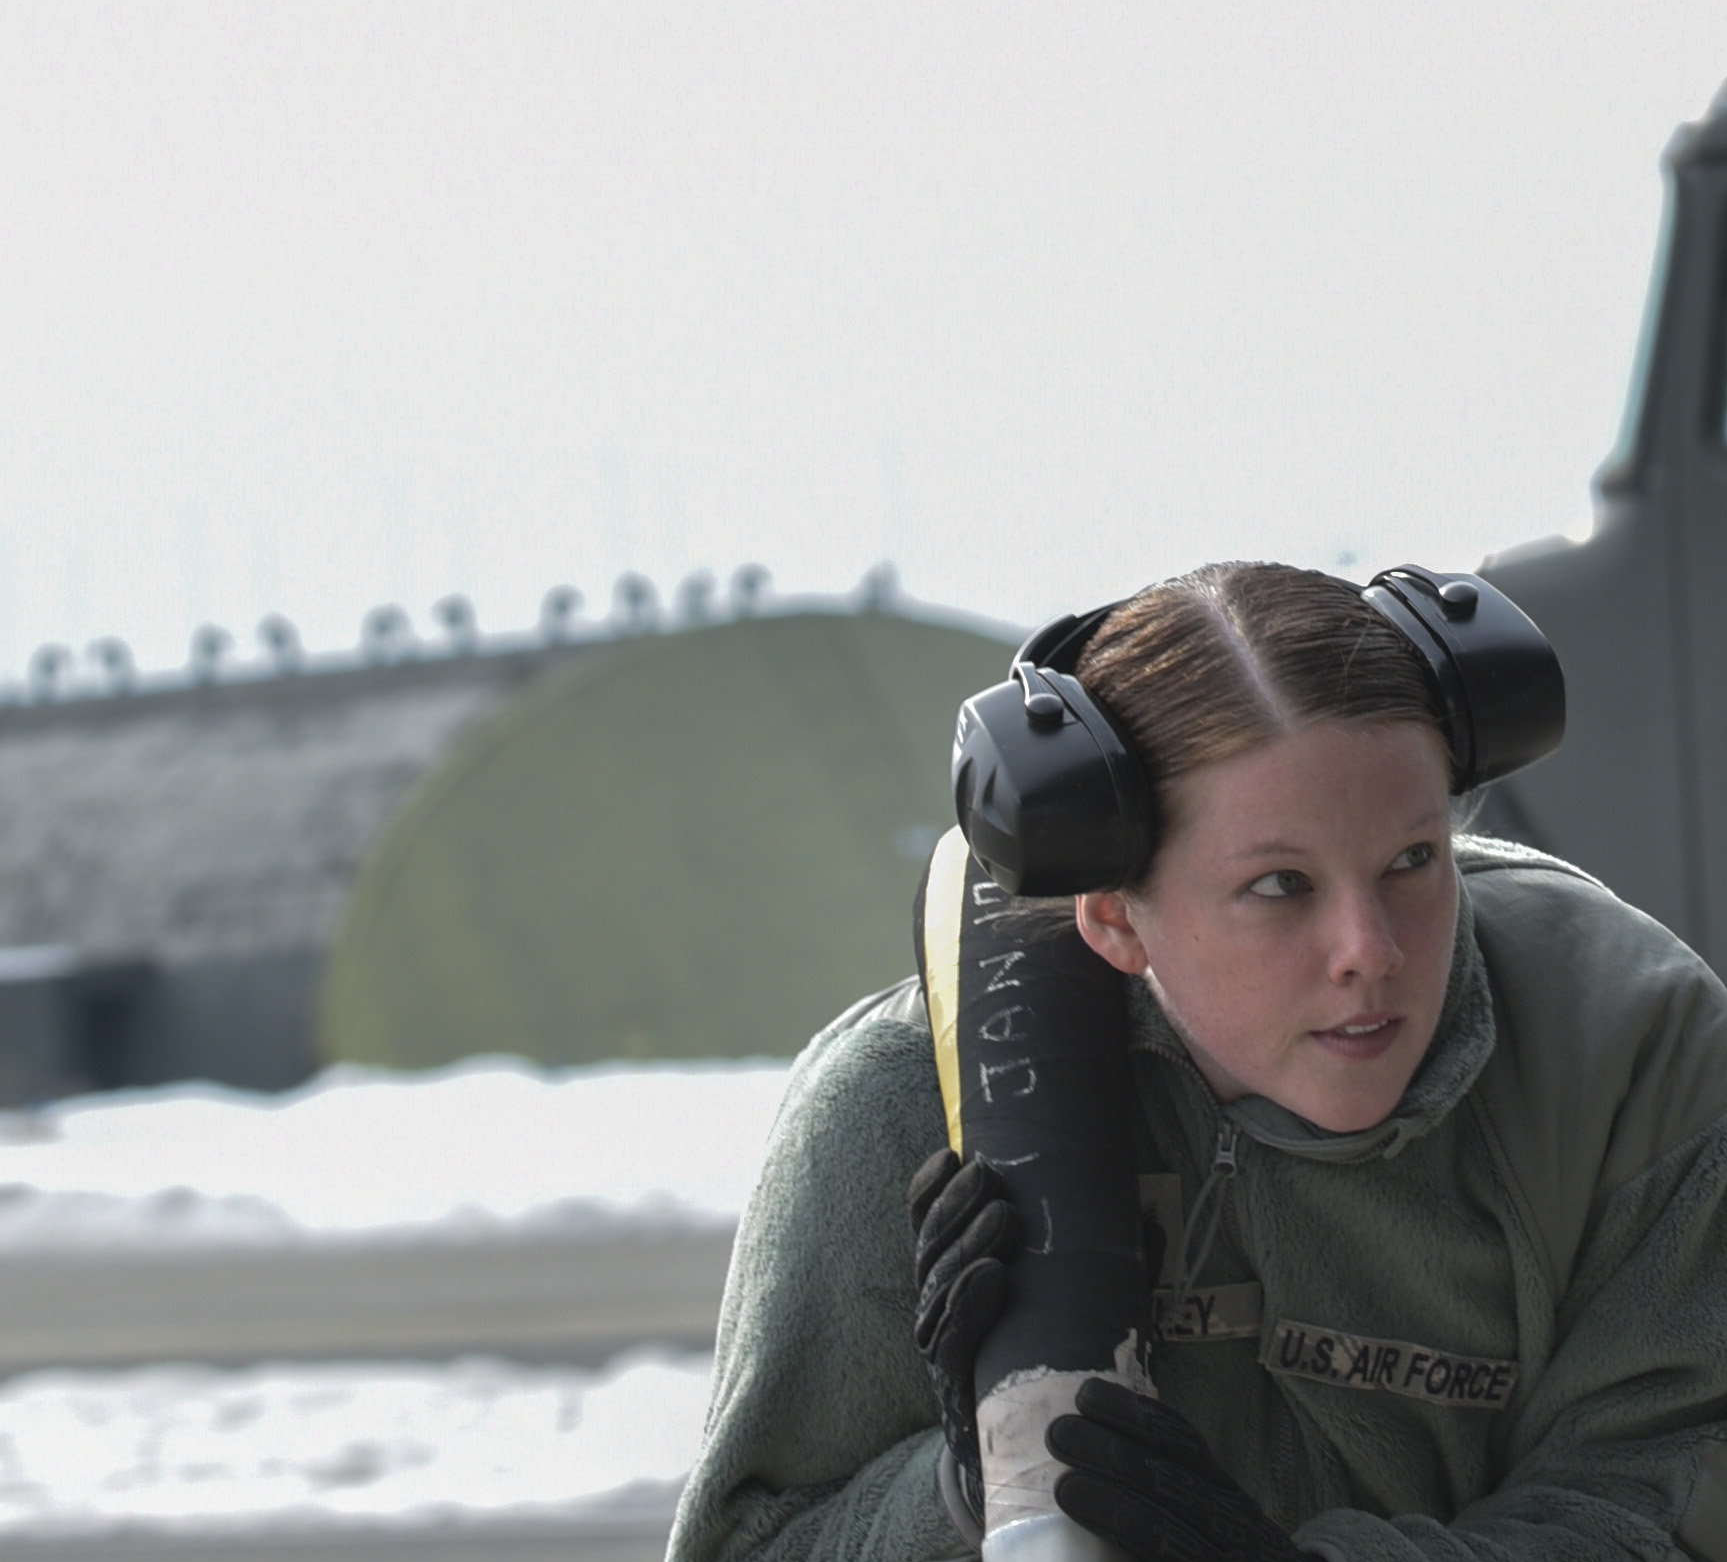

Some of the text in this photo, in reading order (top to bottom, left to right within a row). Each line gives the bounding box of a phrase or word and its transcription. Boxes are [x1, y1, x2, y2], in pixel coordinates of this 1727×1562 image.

[1279, 1328, 1512, 1402] U.S. AIR FORCE
